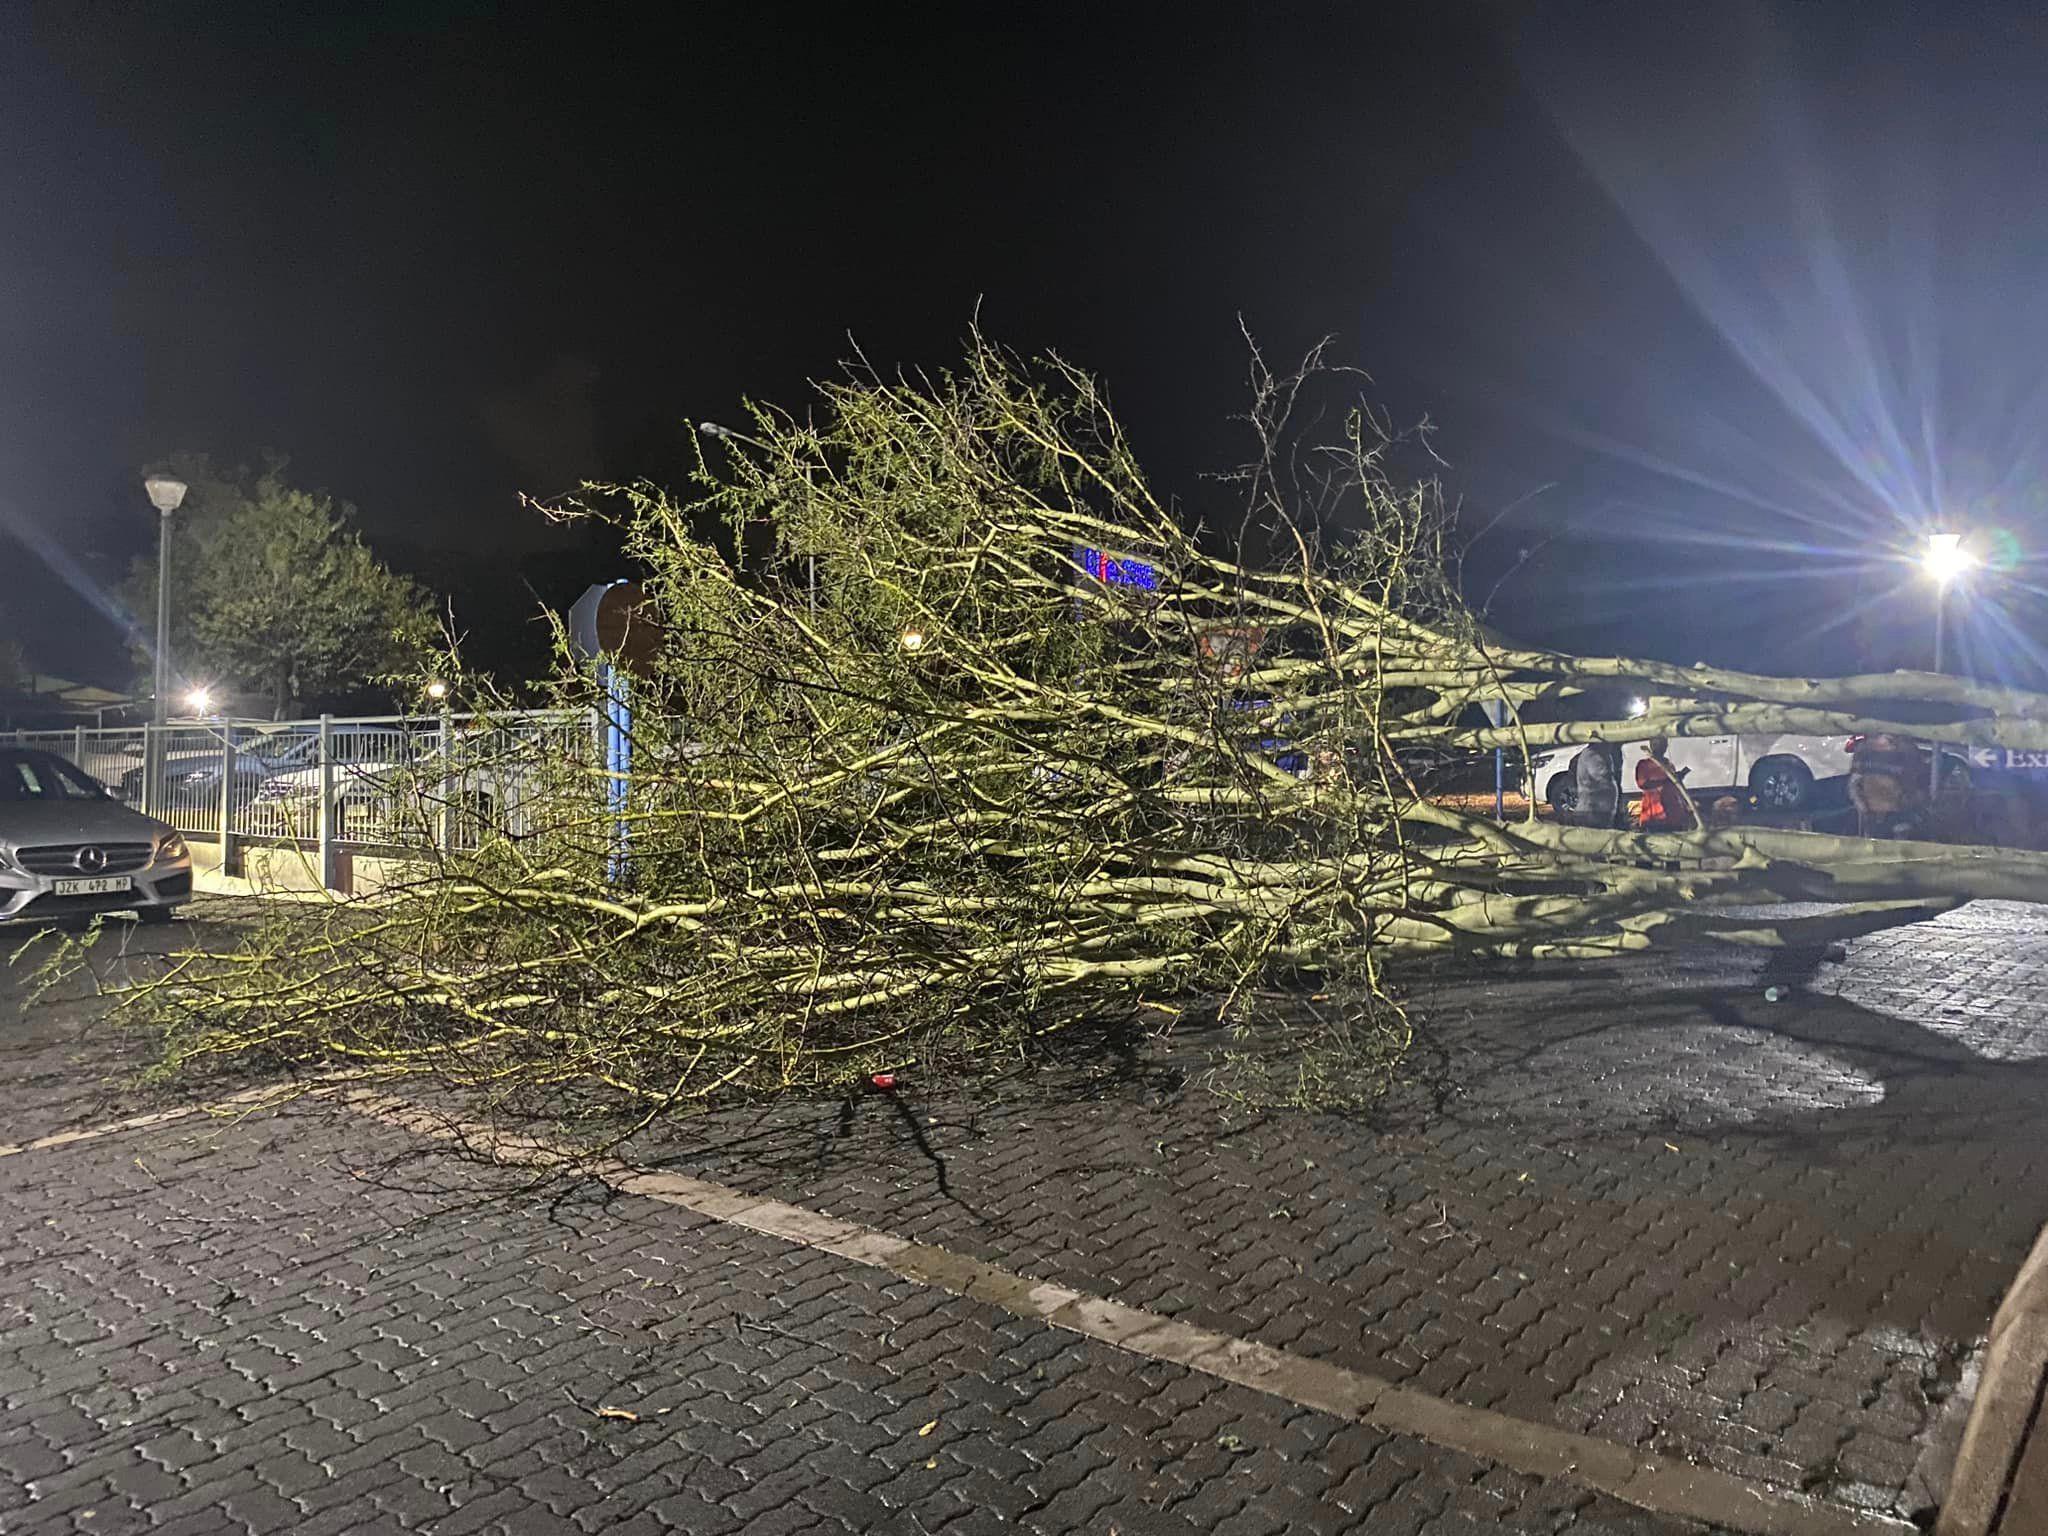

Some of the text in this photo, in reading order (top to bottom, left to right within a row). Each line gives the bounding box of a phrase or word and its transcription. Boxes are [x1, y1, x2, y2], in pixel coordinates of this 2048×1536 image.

[59, 878, 128, 894] JZK 472 MP
